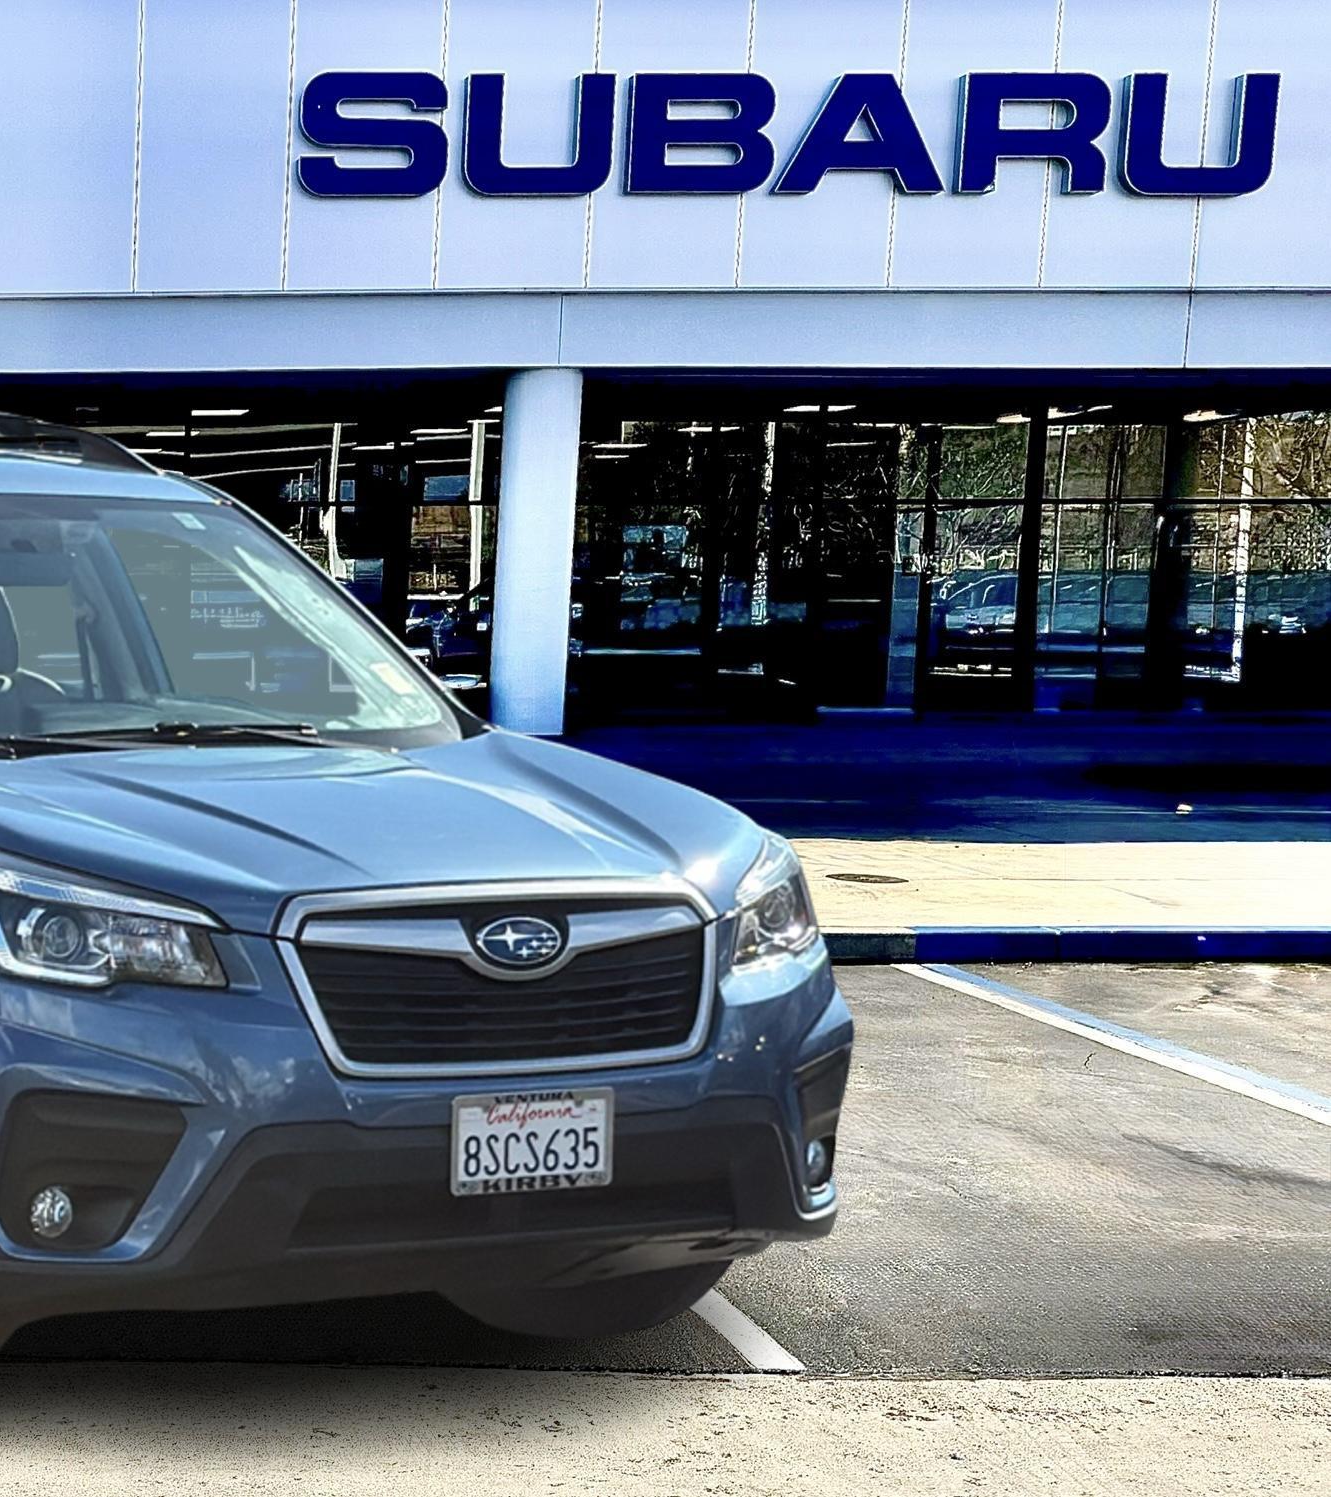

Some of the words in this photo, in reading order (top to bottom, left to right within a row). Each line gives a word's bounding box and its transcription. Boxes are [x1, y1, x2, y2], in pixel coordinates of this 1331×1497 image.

[296, 70, 1281, 198] SUBARU
[486, 1102, 582, 1129] California
[463, 1126, 600, 1178] 8SCS635
[482, 1172, 583, 1193] KIRBY
